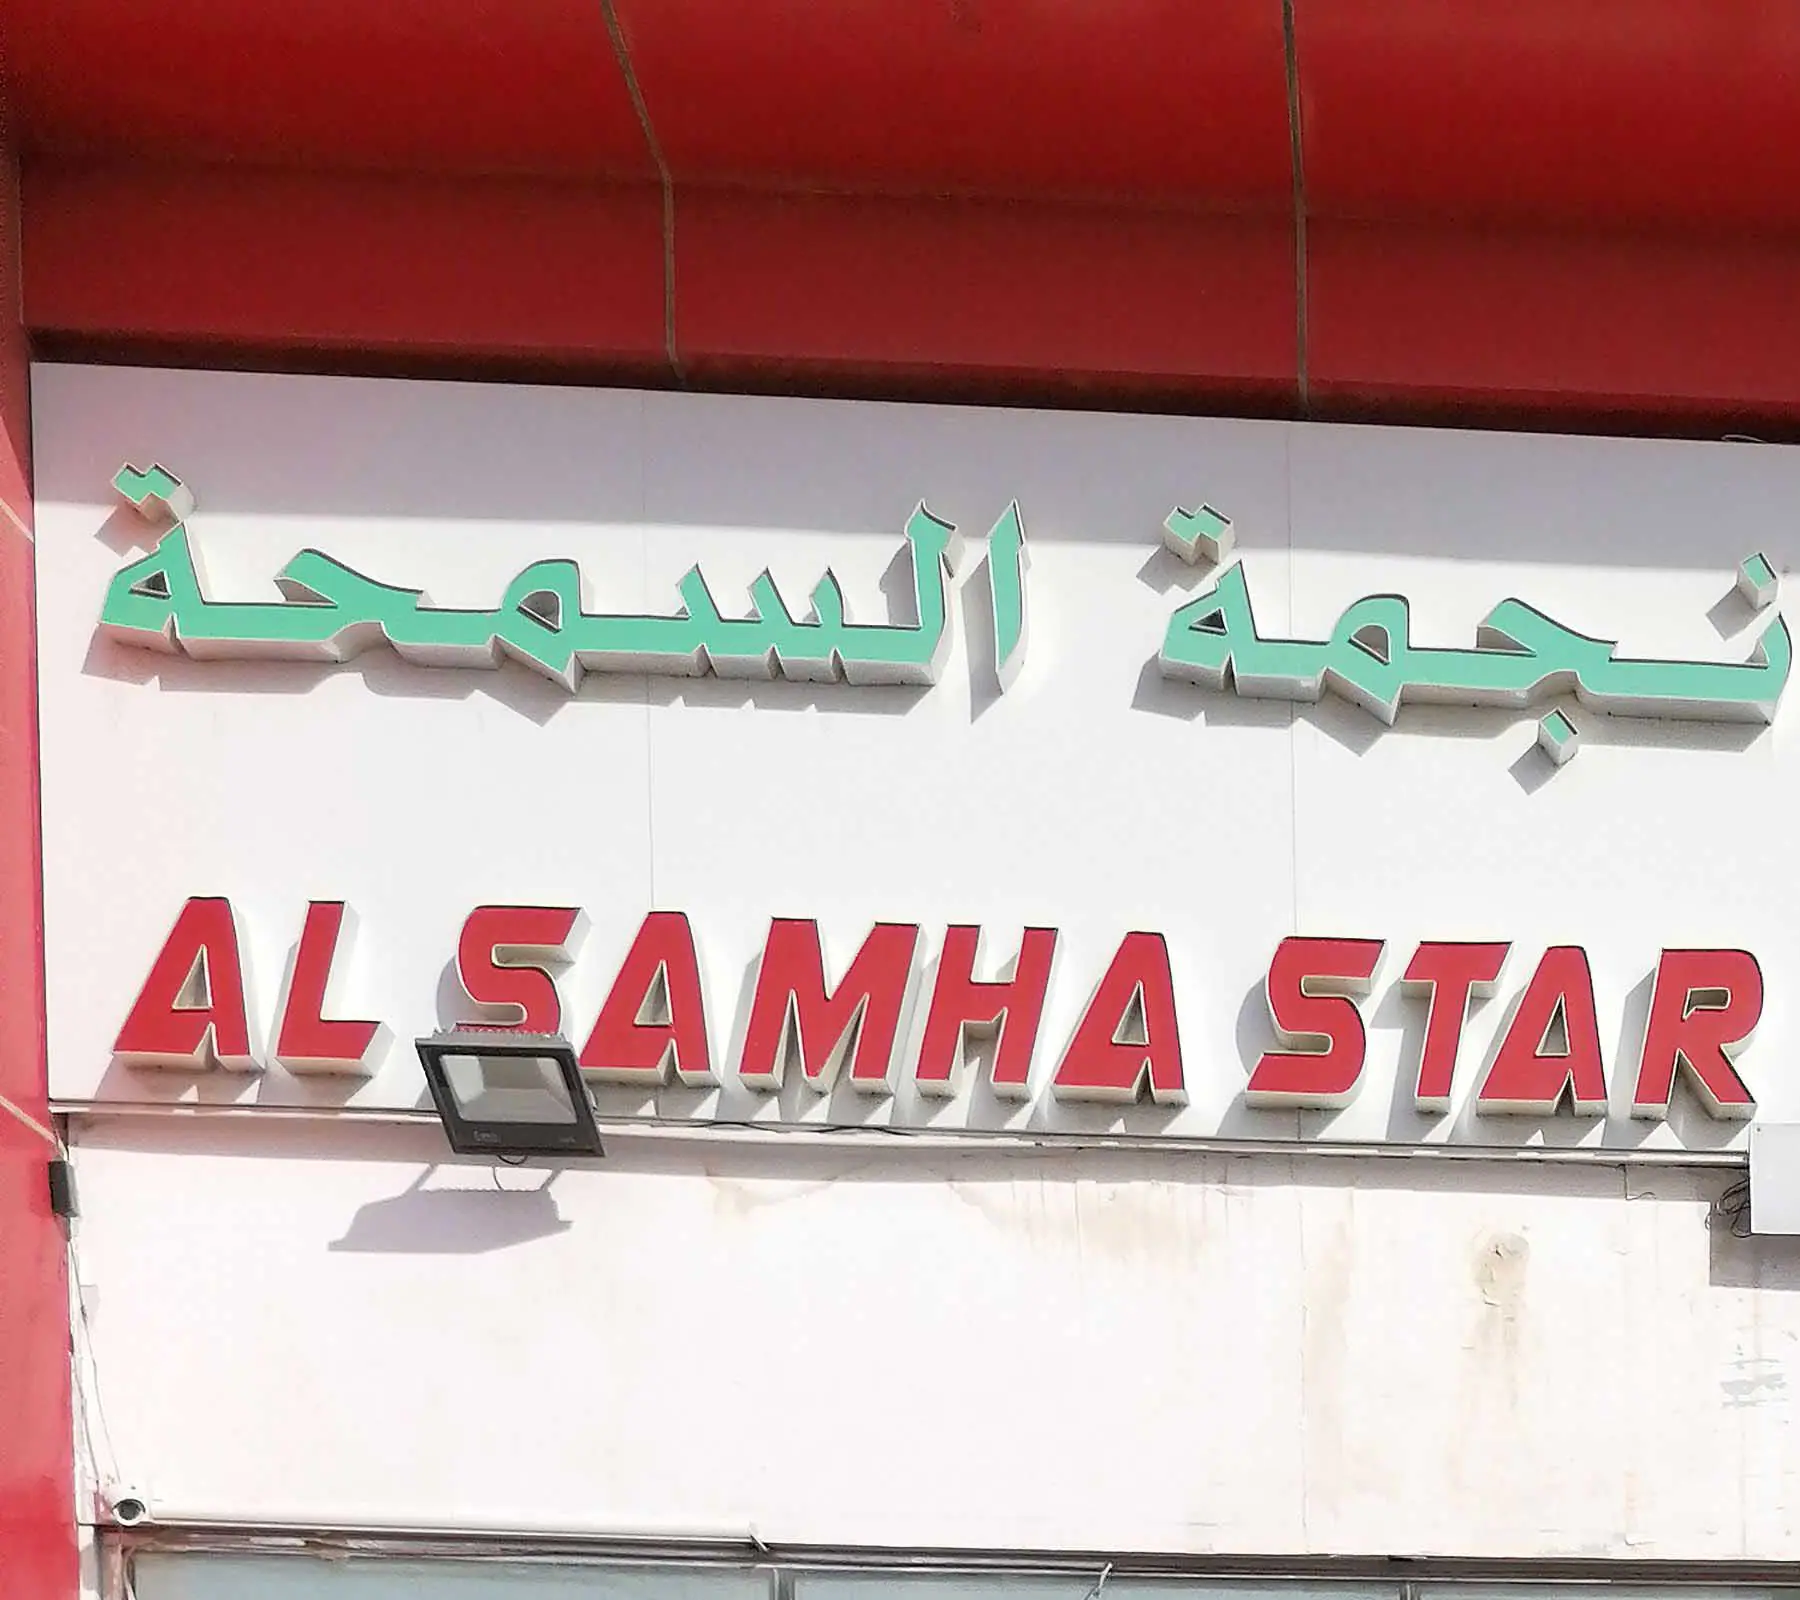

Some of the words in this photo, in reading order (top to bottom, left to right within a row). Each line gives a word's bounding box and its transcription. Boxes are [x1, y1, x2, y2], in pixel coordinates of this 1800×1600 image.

[100, 464, 1028, 690] السمحة
[1161, 504, 1792, 756] نجمة
[112, 896, 380, 1064] AL
[454, 904, 1186, 1094] SAMHA
[1246, 935, 1766, 1110] STAR
